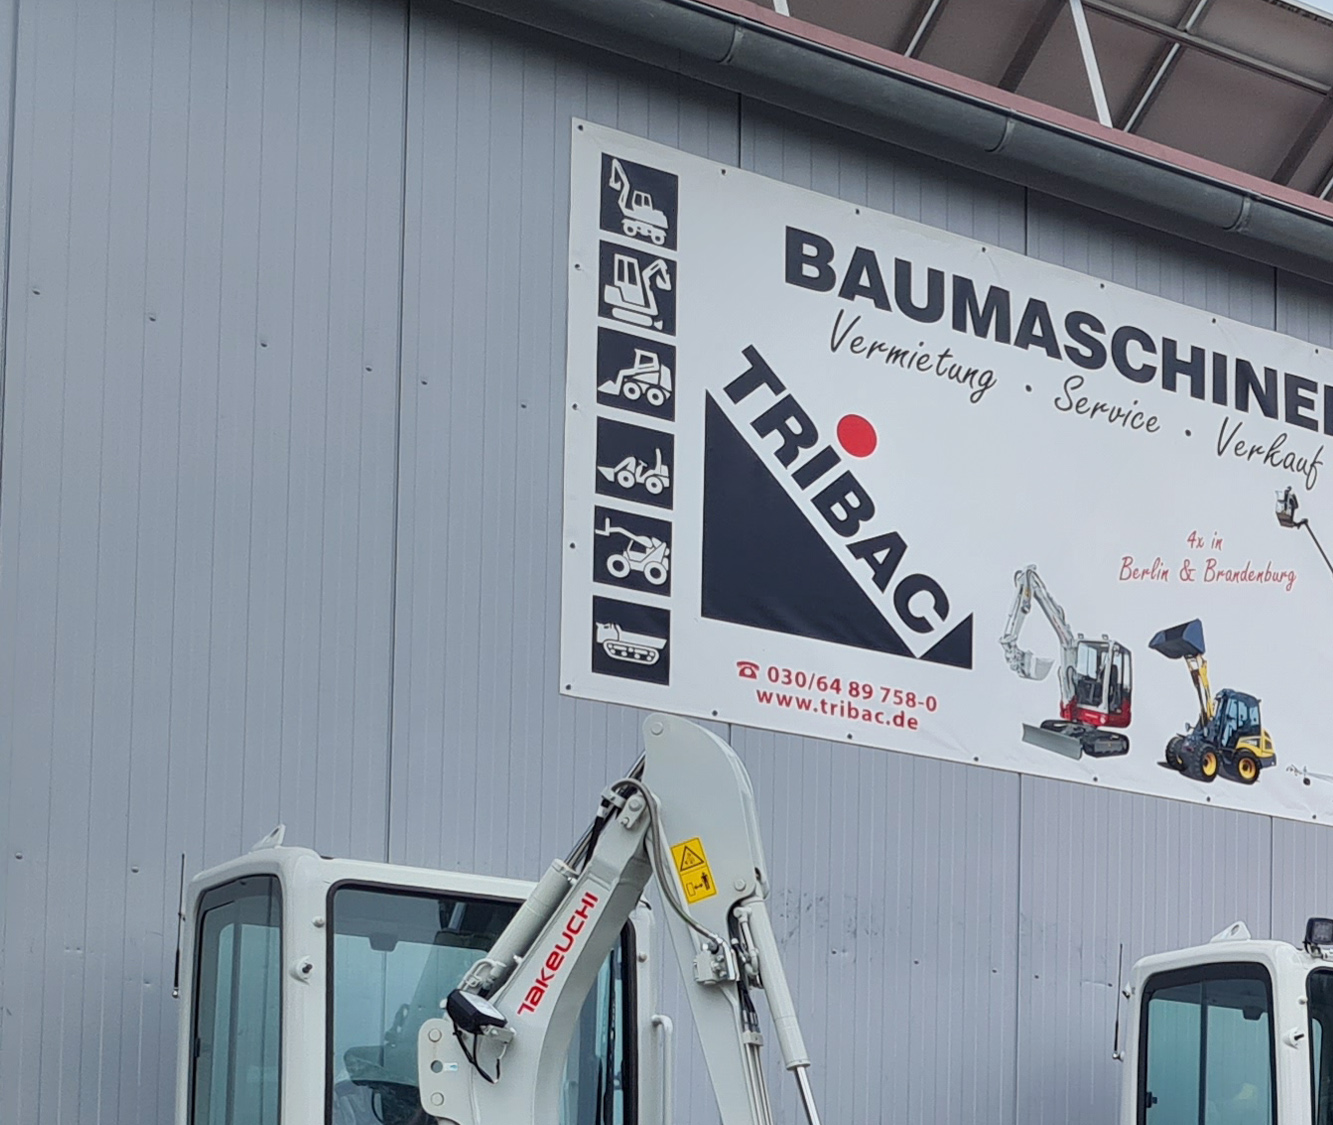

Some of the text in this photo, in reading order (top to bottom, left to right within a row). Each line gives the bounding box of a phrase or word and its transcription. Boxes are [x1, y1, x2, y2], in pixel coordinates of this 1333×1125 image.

[829, 309, 1324, 490] Vermietung Service Verkauf
[723, 344, 950, 634] TRIBAC
[1186, 530, 1224, 551] 4x in
[1118, 556, 1297, 592] Berlin & Brandenburg
[756, 687, 918, 730] www.tribac.de
[767, 665, 938, 712] 030/64 89 758-0
[517, 892, 598, 1015] TAKEUCHI
